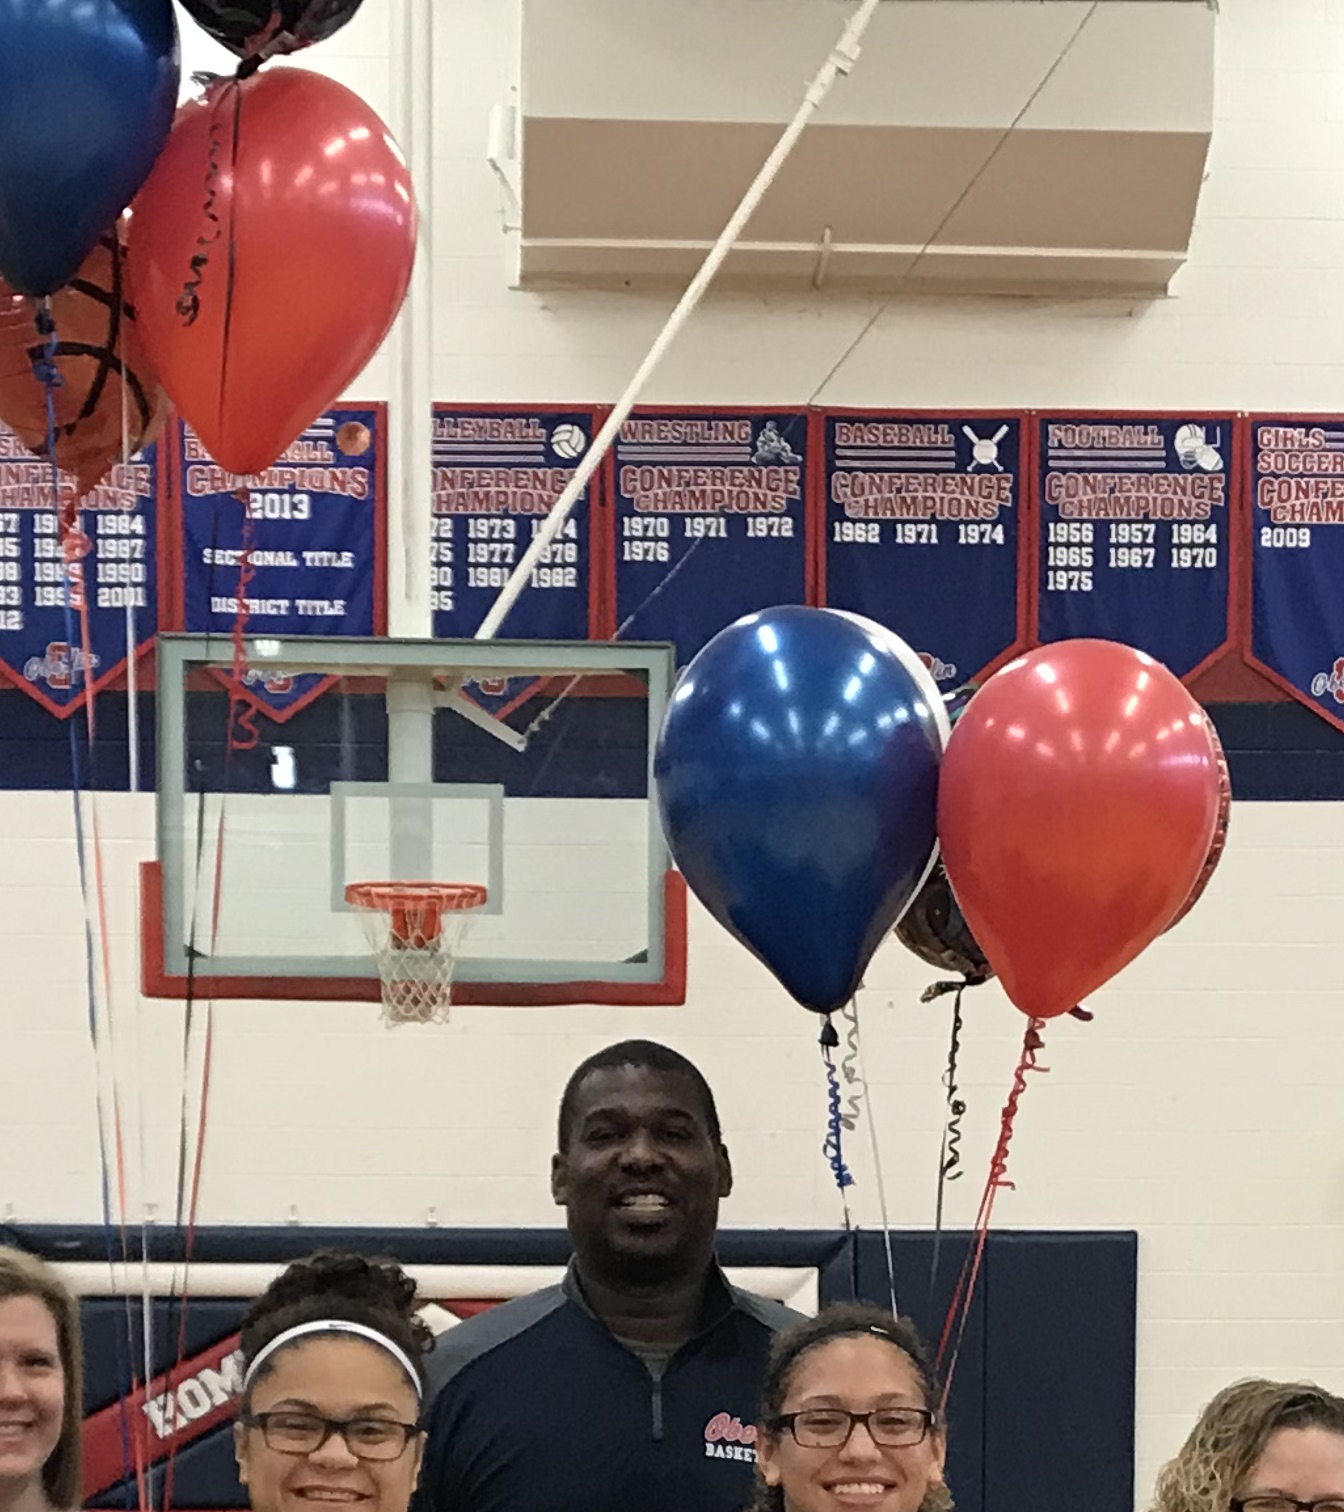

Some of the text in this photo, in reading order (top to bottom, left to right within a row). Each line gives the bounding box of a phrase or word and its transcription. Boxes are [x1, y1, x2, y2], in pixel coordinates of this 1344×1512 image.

[620, 420, 751, 443] WRESTLING
[835, 423, 954, 447] BASEBALL
[1048, 425, 1164, 448] FOOTBALL
[1258, 427, 1325, 449] GIRLS
[620, 465, 801, 499] CONFERENCE
[832, 472, 1013, 506] CONFERENCE
[1046, 472, 1225, 506] CONFERENCE
[247, 493, 311, 519] 2013
[633, 487, 787, 514] CHAMPIONS
[845, 494, 999, 520] CHAMPIONS
[1059, 495, 1211, 520] CHAMPIONS
[468, 518, 516, 538] 1973
[623, 517, 794, 537] 1970 1971 1972
[833, 522, 1004, 545] 1962 1971 1974
[1048, 523, 1217, 544] 1956 1957 1964
[1260, 527, 1311, 548] 2009
[303, 551, 355, 569] TITLE
[468, 543, 515, 563] 1977
[623, 541, 669, 562] 1976
[1048, 547, 1217, 568] 1965 1967 1970
[1047, 571, 1093, 591] 1975
[295, 600, 347, 616] TITLE
